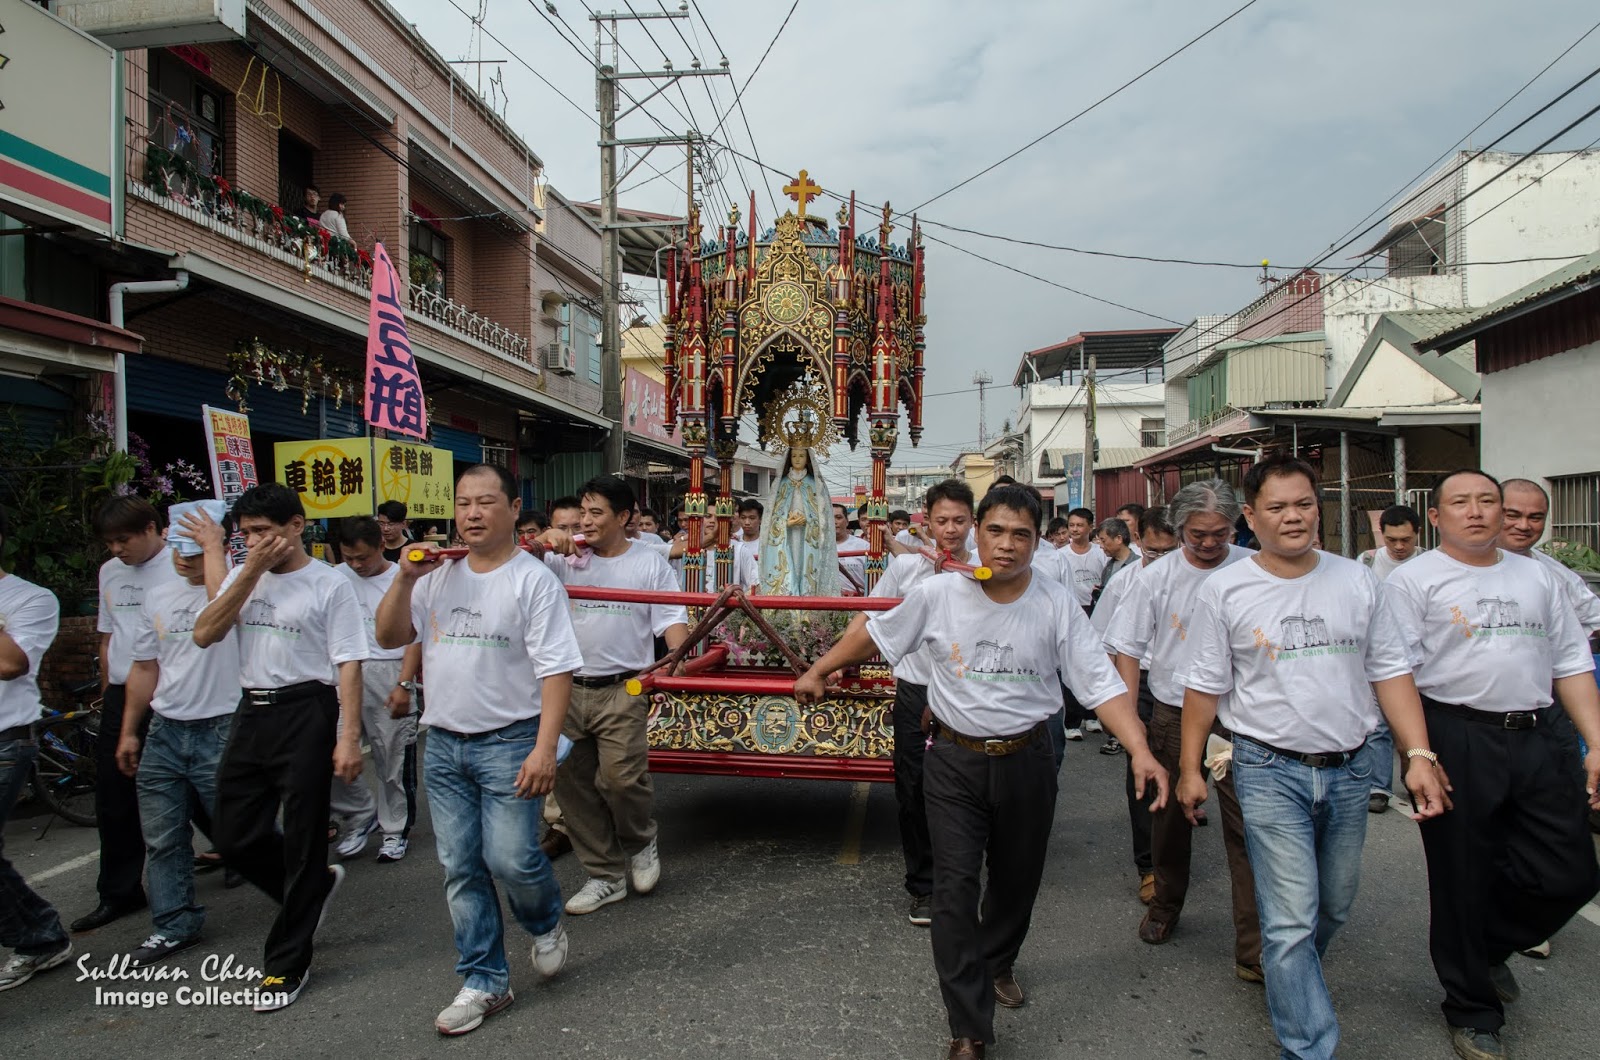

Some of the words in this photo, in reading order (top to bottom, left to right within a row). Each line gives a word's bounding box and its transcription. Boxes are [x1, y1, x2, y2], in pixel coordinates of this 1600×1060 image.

[390, 445, 433, 476] 車輪餅
[285, 457, 363, 497] 車輪餅
[1496, 628, 1518, 636] CHIN
[1277, 651, 1298, 661] WAN
[965, 672, 982, 681] WAN
